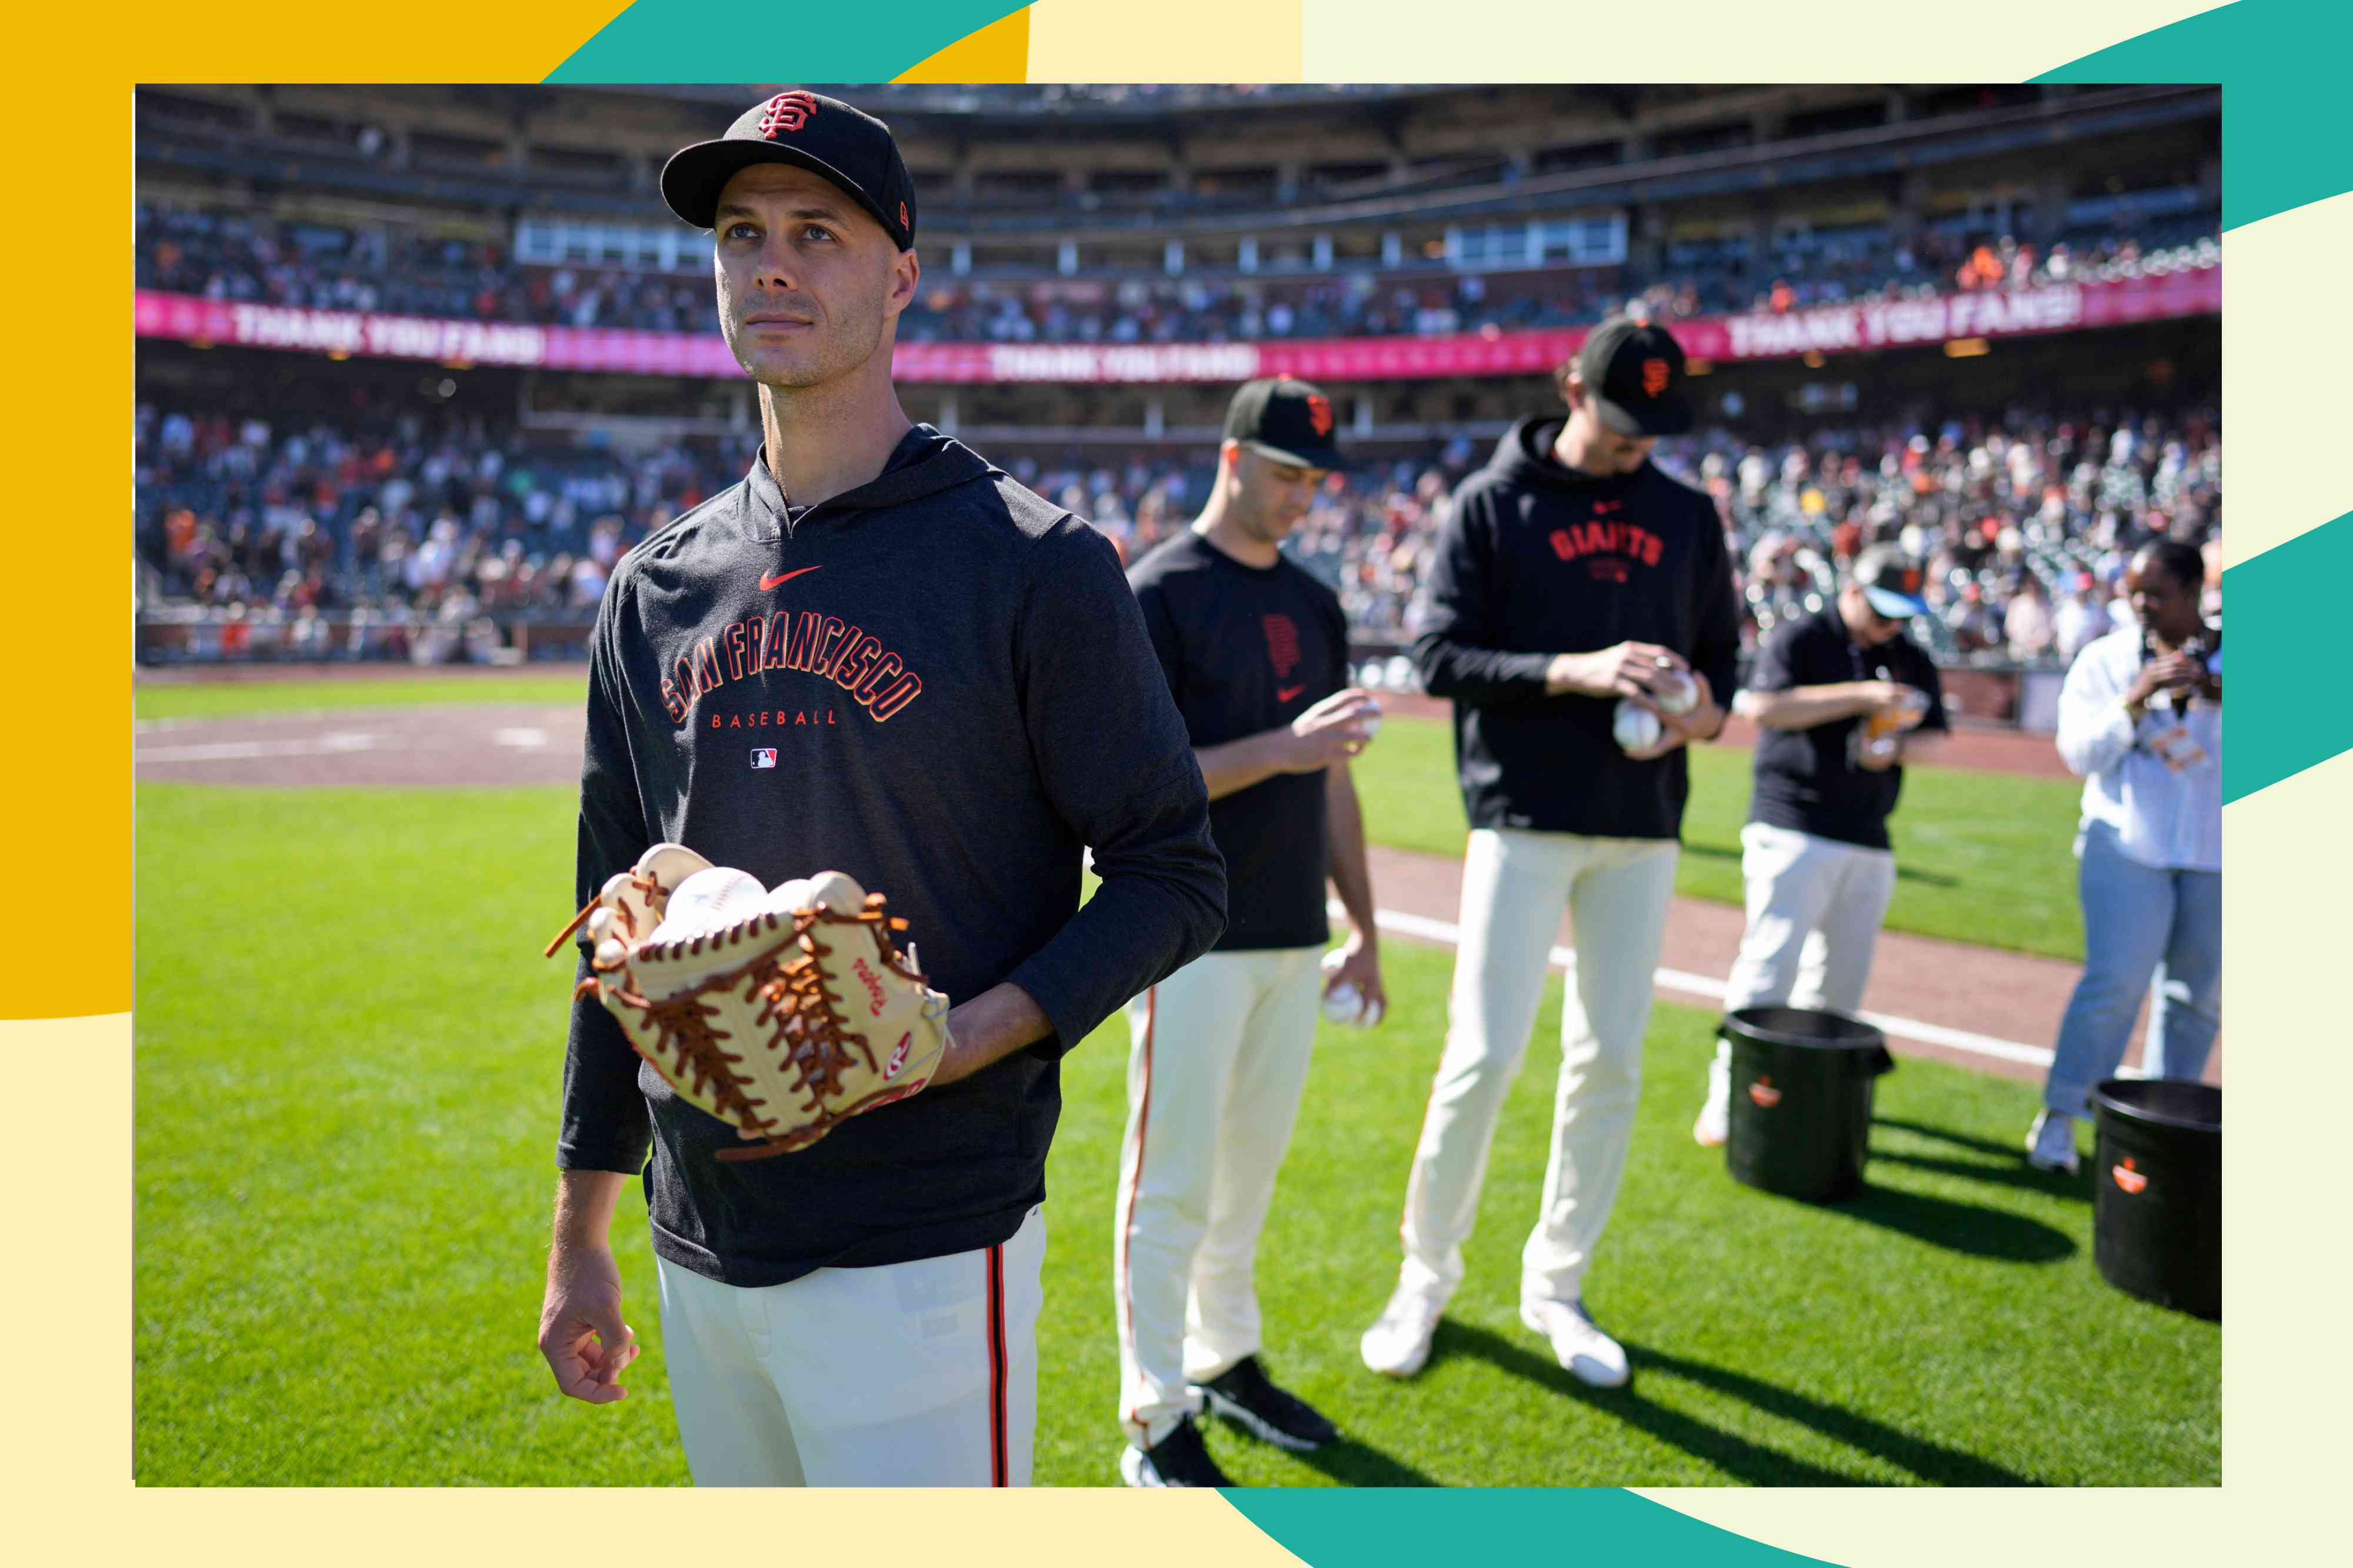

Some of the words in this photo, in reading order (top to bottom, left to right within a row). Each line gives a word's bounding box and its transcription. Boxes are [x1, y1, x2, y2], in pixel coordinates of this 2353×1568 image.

[1549, 520, 1664, 567] GIANTS
[660, 636, 724, 723] SAN
[724, 611, 922, 722] FRANCISCO
[711, 709, 836, 729] BASEBALL
